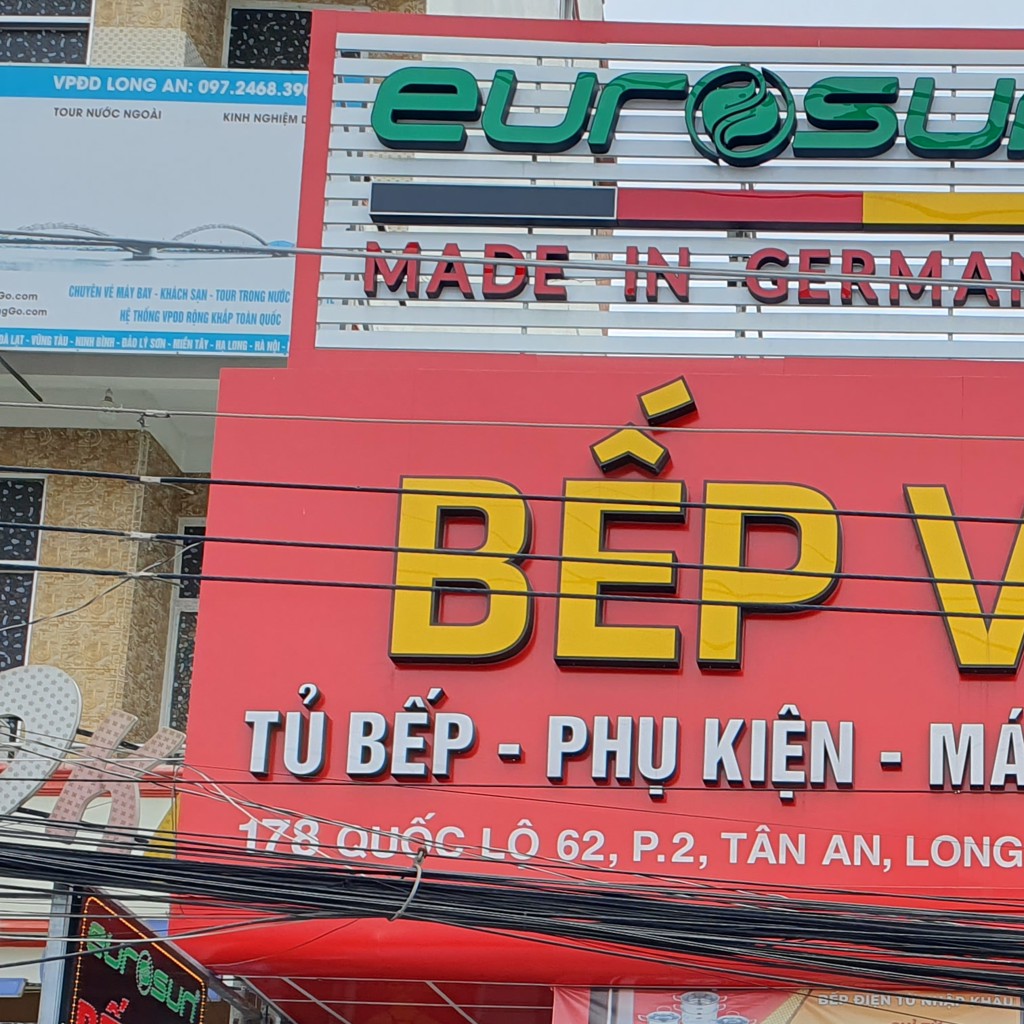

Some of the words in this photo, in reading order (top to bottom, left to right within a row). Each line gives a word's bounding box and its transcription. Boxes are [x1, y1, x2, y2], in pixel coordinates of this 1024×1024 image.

[53, 75, 101, 92] VPĐD
[107, 76, 156, 92] LONG
[162, 78, 193, 93] AN:
[54, 107, 83, 118] TOUR
[86, 106, 121, 119] NƯỚC
[123, 108, 162, 120] NGOÀI
[223, 112, 250, 123] KINH
[253, 112, 298, 126] NGHIỆM
[363, 240, 569, 300] MADE
[625, 245, 690, 302] IN
[389, 375, 844, 671] BẾP
[244, 683, 330, 777] TỦ
[346, 686, 476, 778] BẾP
[546, 715, 681, 801] PHỤ
[702, 704, 854, 805] KIỆN
[238, 818, 319, 857] 178
[335, 813, 466, 860] QUỐC
[480, 819, 539, 869] LỘ
[720, 826, 805, 866] TÂN
[822, 833, 893, 873] AN,
[905, 835, 1023, 868] LONG
